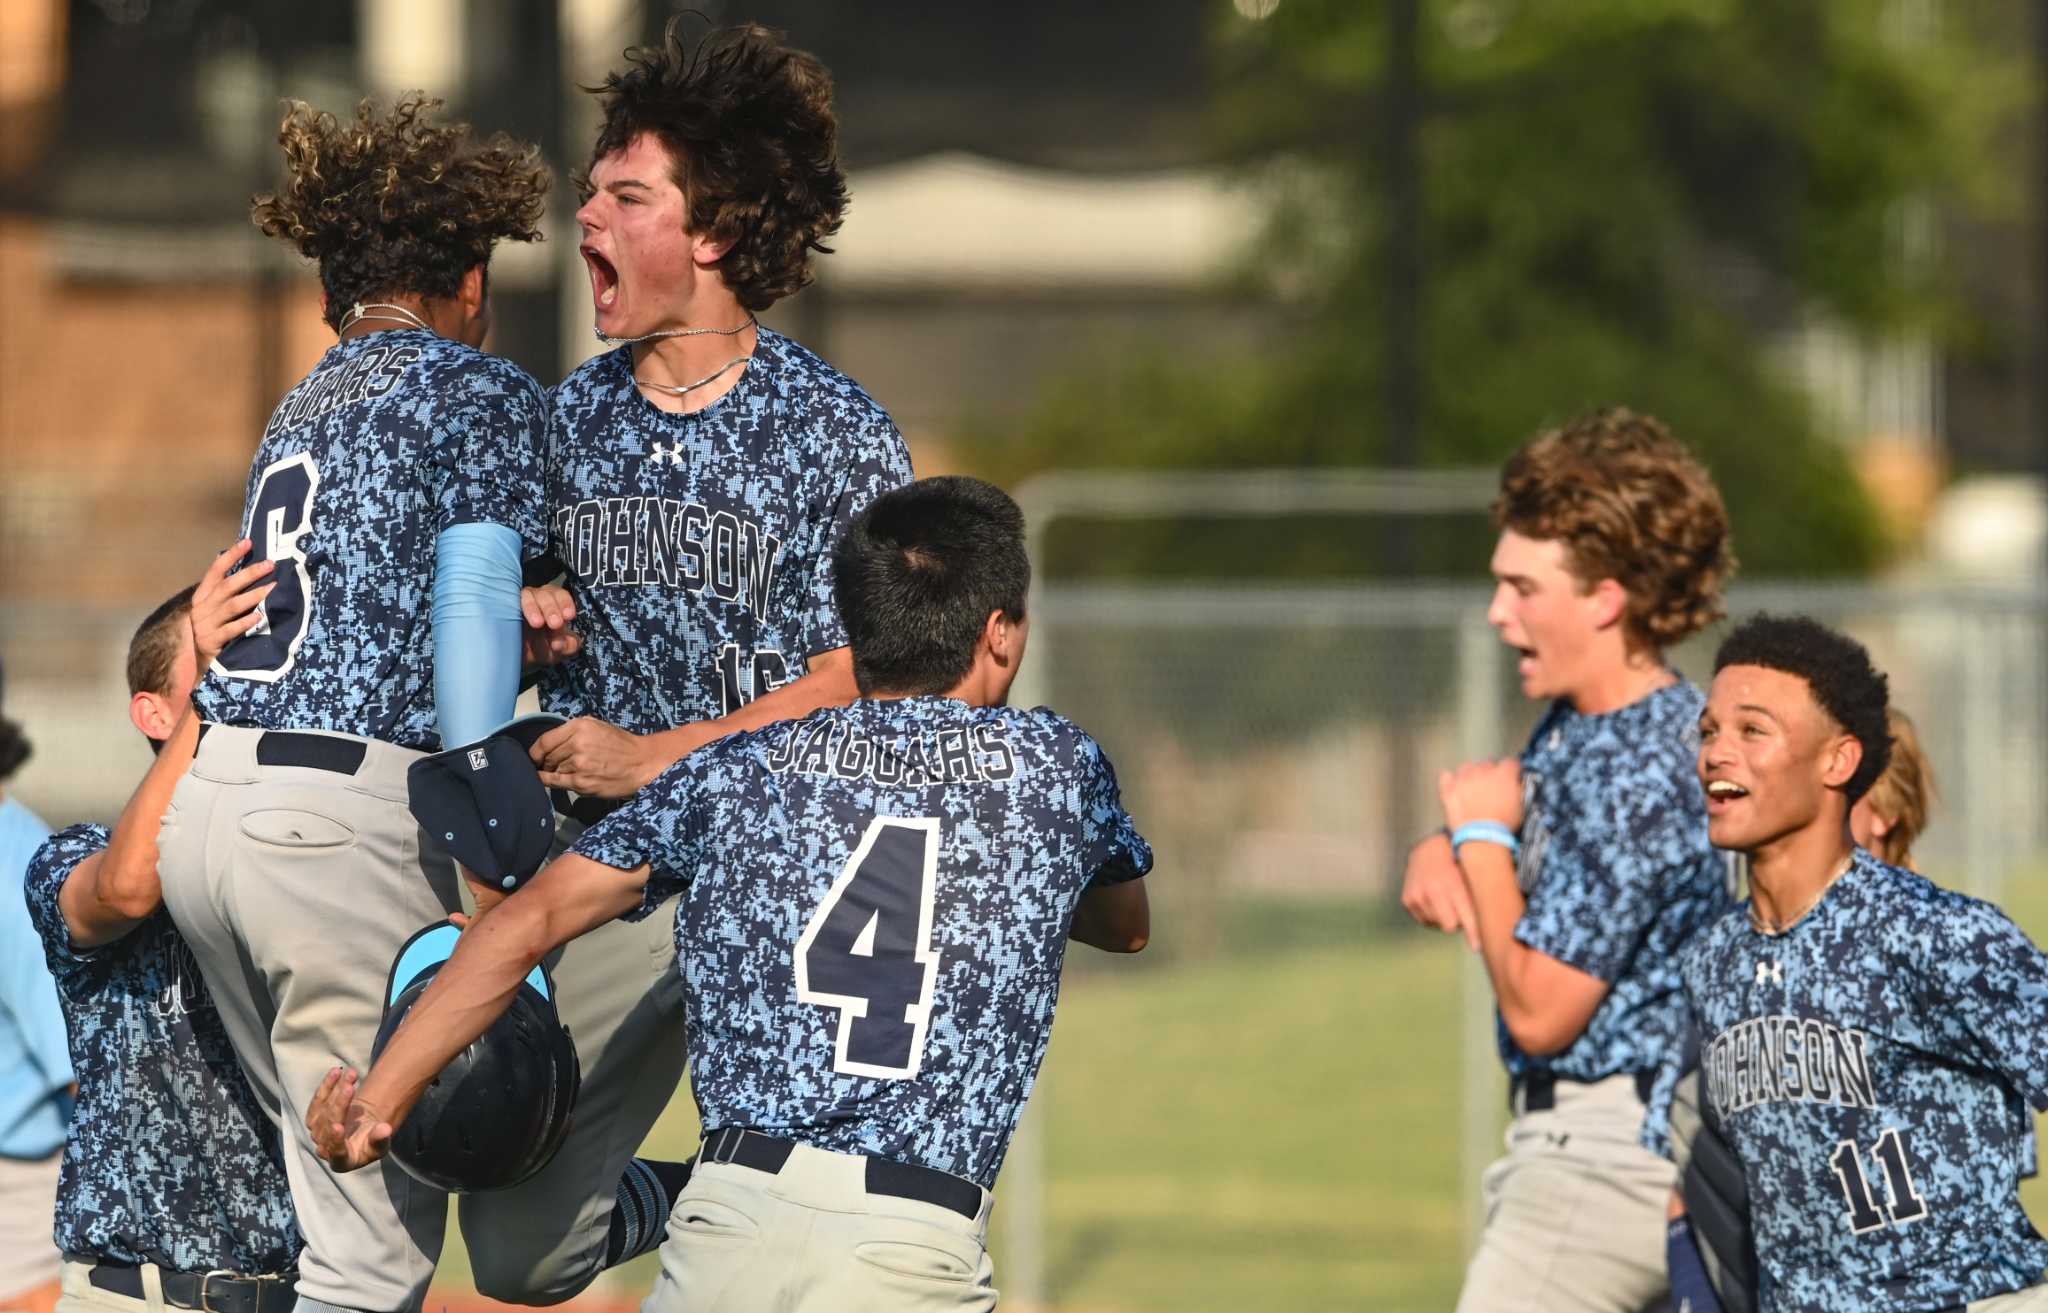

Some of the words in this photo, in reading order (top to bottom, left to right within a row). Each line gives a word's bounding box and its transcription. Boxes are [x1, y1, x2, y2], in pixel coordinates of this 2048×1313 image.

[262, 347, 422, 442] GUARS
[767, 718, 1017, 788] JAGUARS
[794, 815, 940, 1079] 4
[1829, 1127, 1928, 1235] 11
